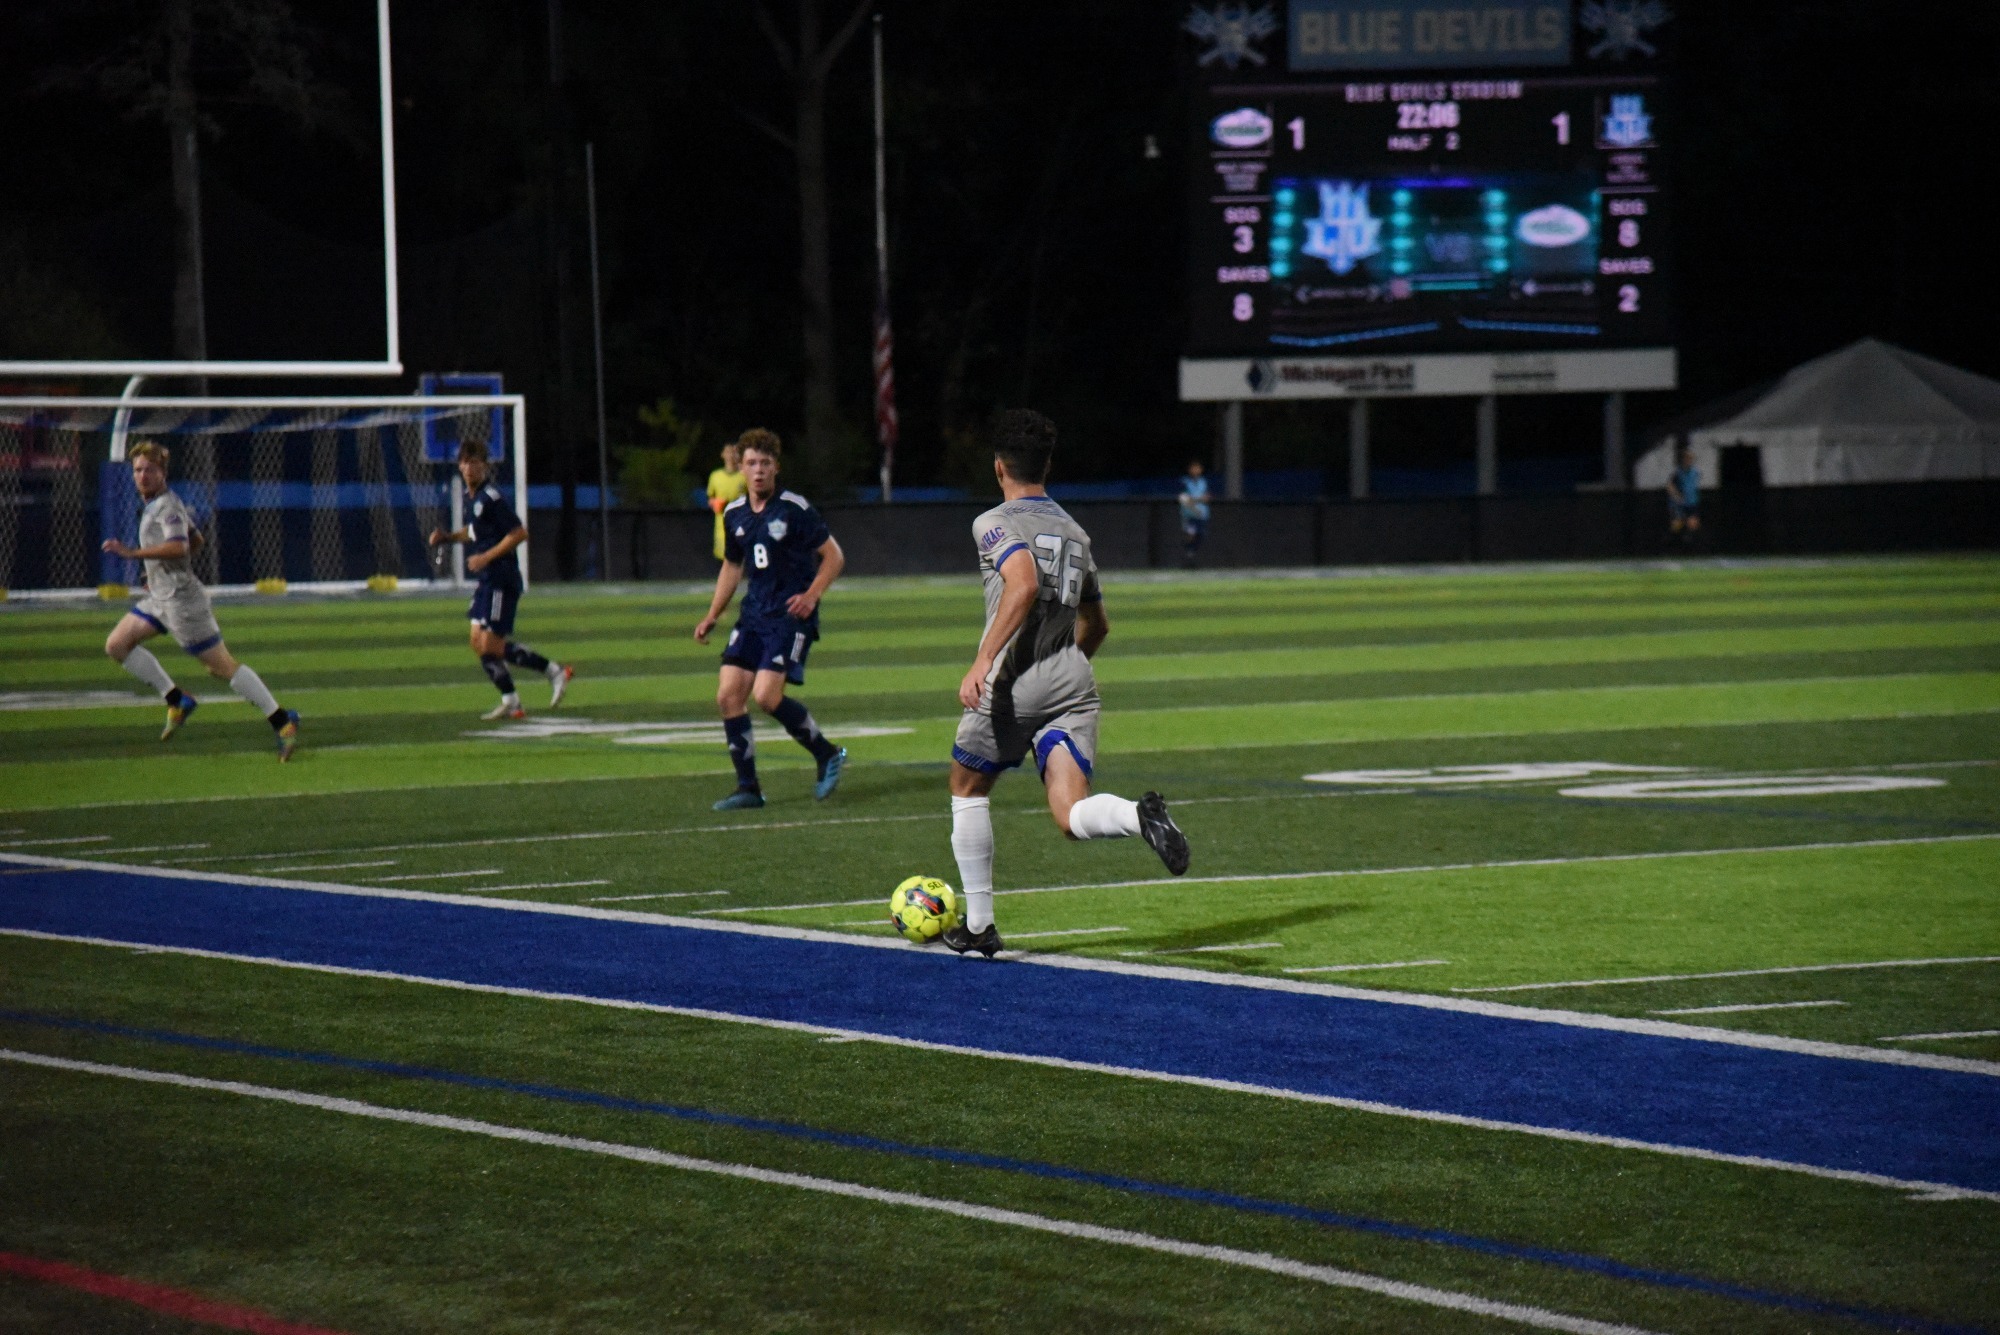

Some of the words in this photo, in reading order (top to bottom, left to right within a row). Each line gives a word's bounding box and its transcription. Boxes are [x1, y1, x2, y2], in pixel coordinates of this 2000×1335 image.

[1299, 10, 1400, 54] BLUE
[1412, 7, 1563, 51] DEVILS
[1287, 116, 1305, 150] 1
[1551, 111, 1570, 145] 1
[1233, 225, 1254, 253] 3
[1618, 283, 1640, 313] 2
[753, 543, 769, 569] 8
